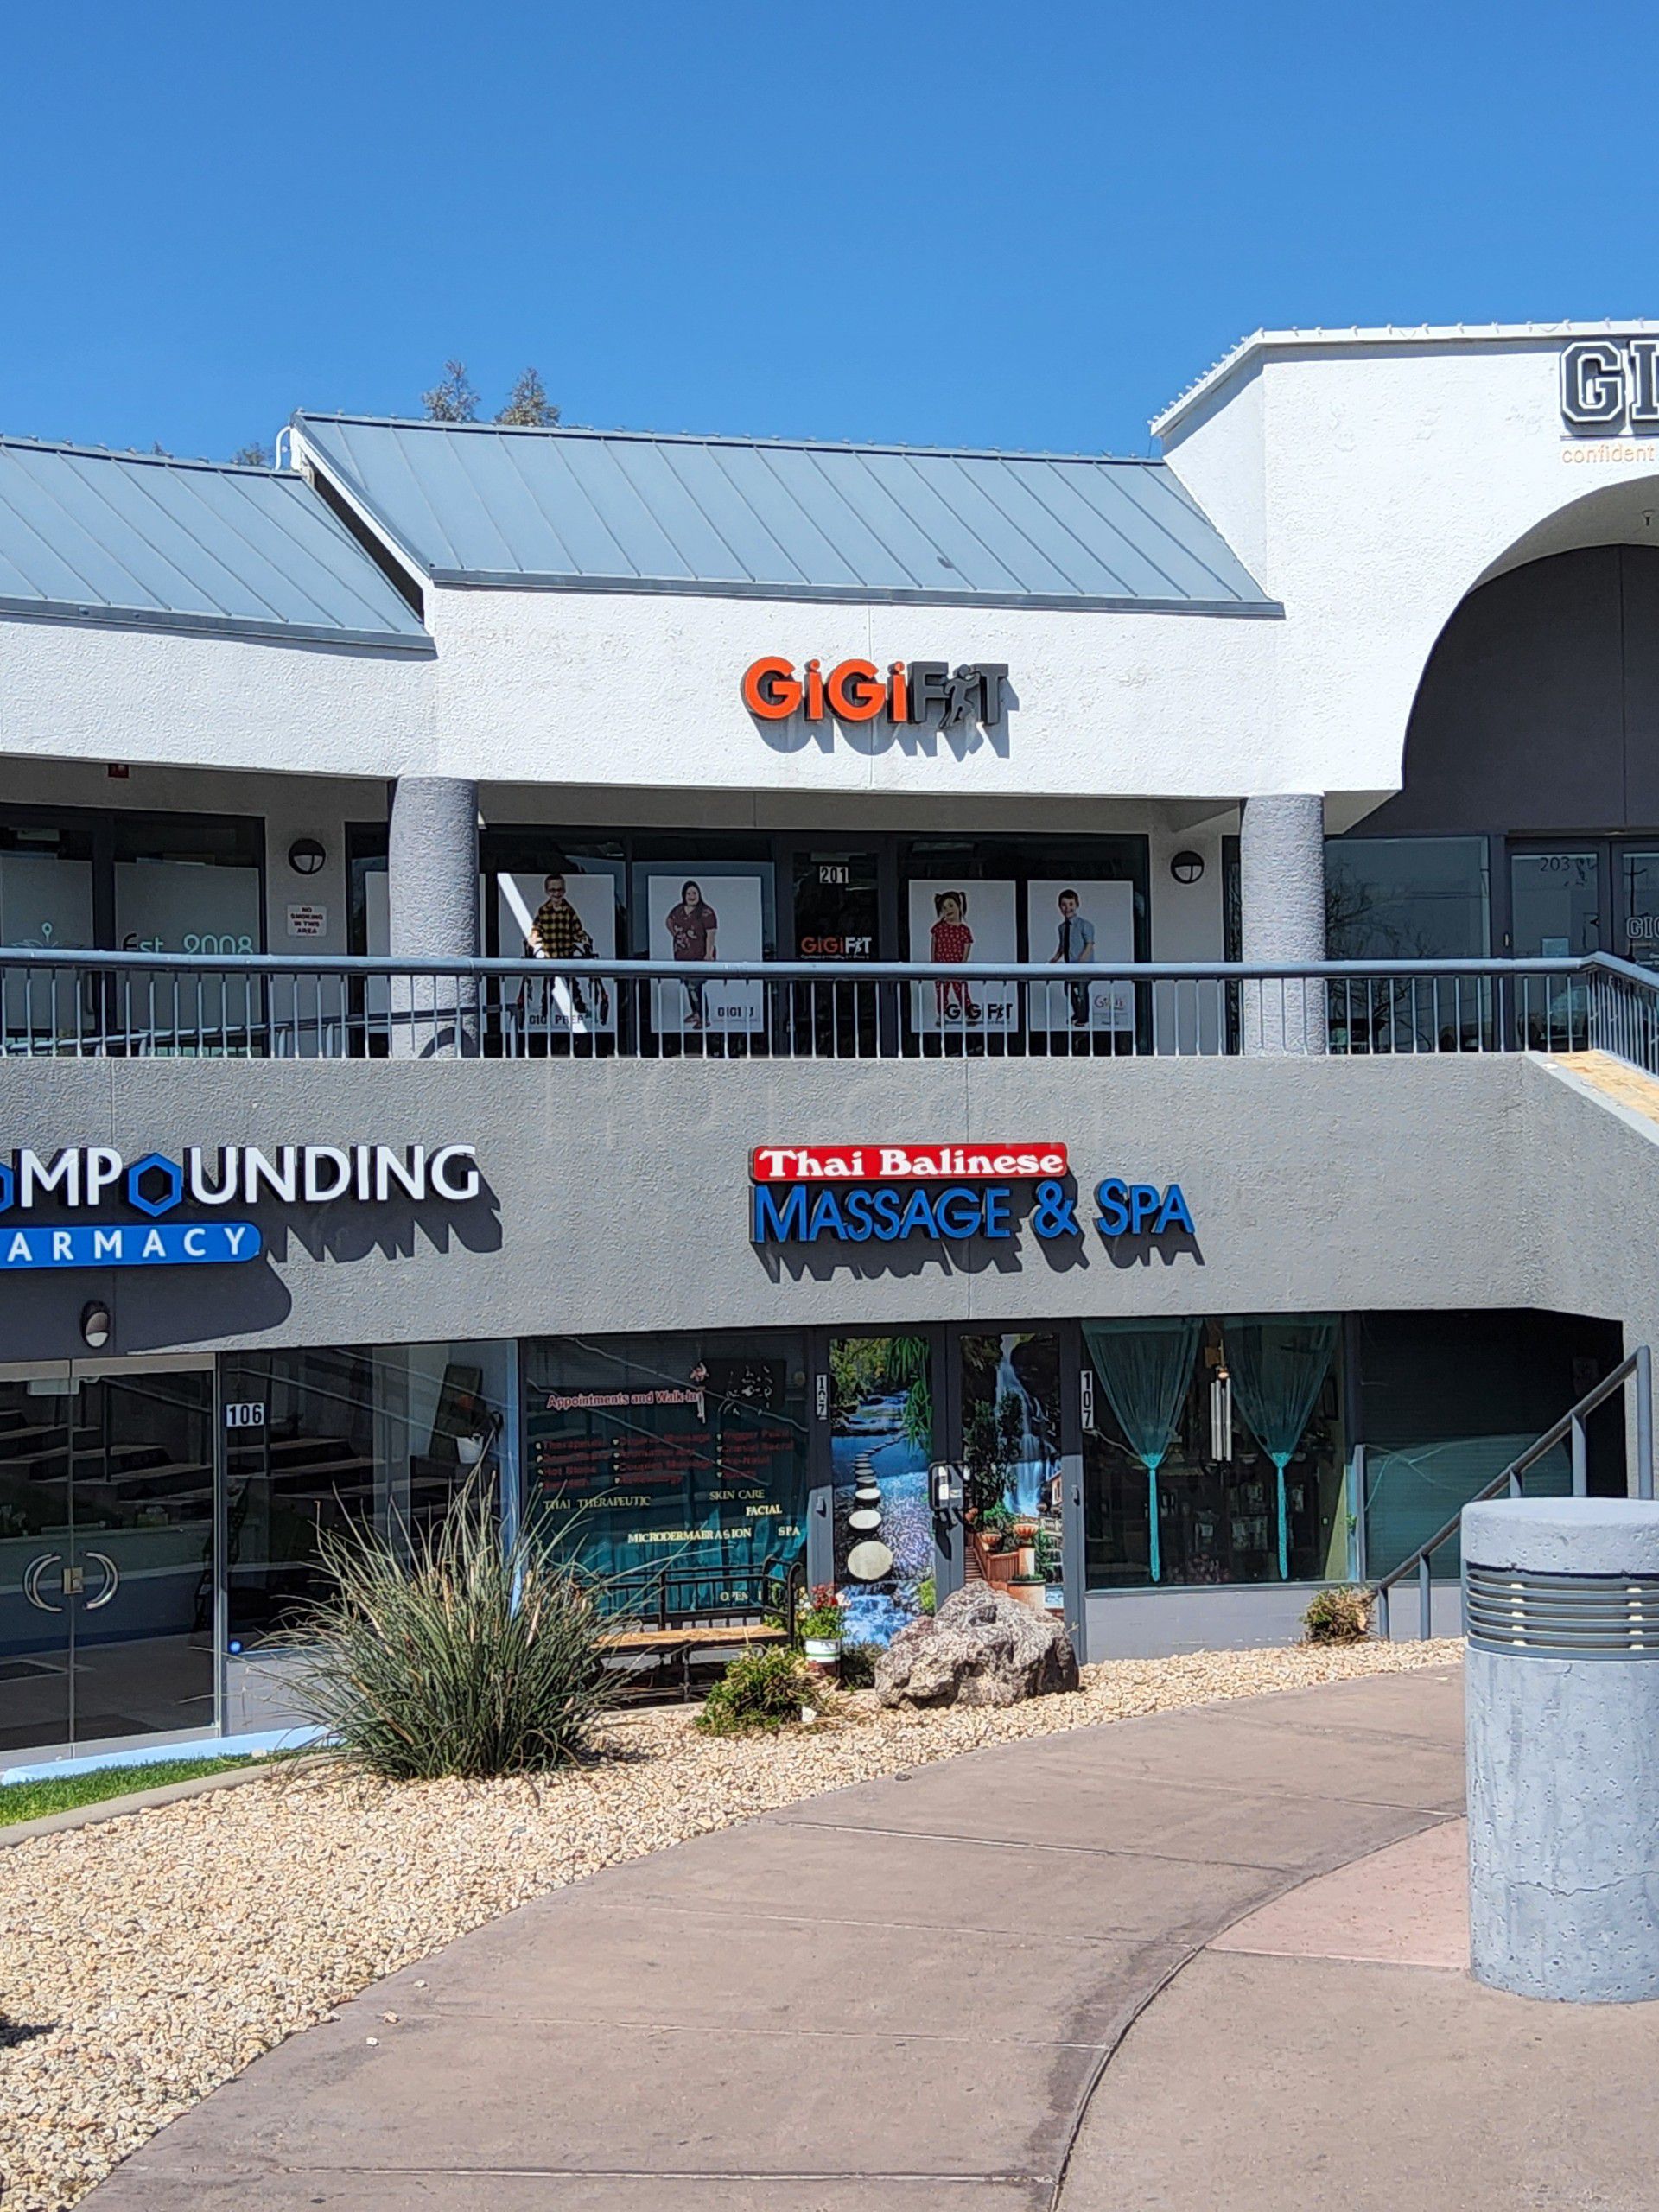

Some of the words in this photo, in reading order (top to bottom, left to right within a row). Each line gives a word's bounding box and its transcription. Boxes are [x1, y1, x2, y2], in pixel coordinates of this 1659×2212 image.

[1562, 444, 1655, 463] confident
[1540, 853, 1571, 872] 203
[821, 867, 846, 883] 201
[759, 1149, 865, 1179] Thai
[879, 1146, 1065, 1178] Balinese
[0, 1145, 480, 1217] MPOUNDING
[753, 1185, 1011, 1243] MASSAGE
[1033, 1179, 1079, 1239] &
[1096, 1178, 1196, 1237] SPA
[7, 1228, 245, 1262] ARMACY
[547, 1392, 629, 1411] Appointments
[631, 1391, 653, 1404] and
[1083, 1371, 1092, 1427] 107
[229, 1404, 262, 1426] 106
[543, 1499, 571, 1510] THAI
[577, 1496, 652, 1508] THERAPEUTIC
[709, 1490, 735, 1501] SKIN
[738, 1489, 766, 1499] CARE
[746, 1504, 783, 1516] FACIAL
[778, 1525, 800, 1537] SPA
